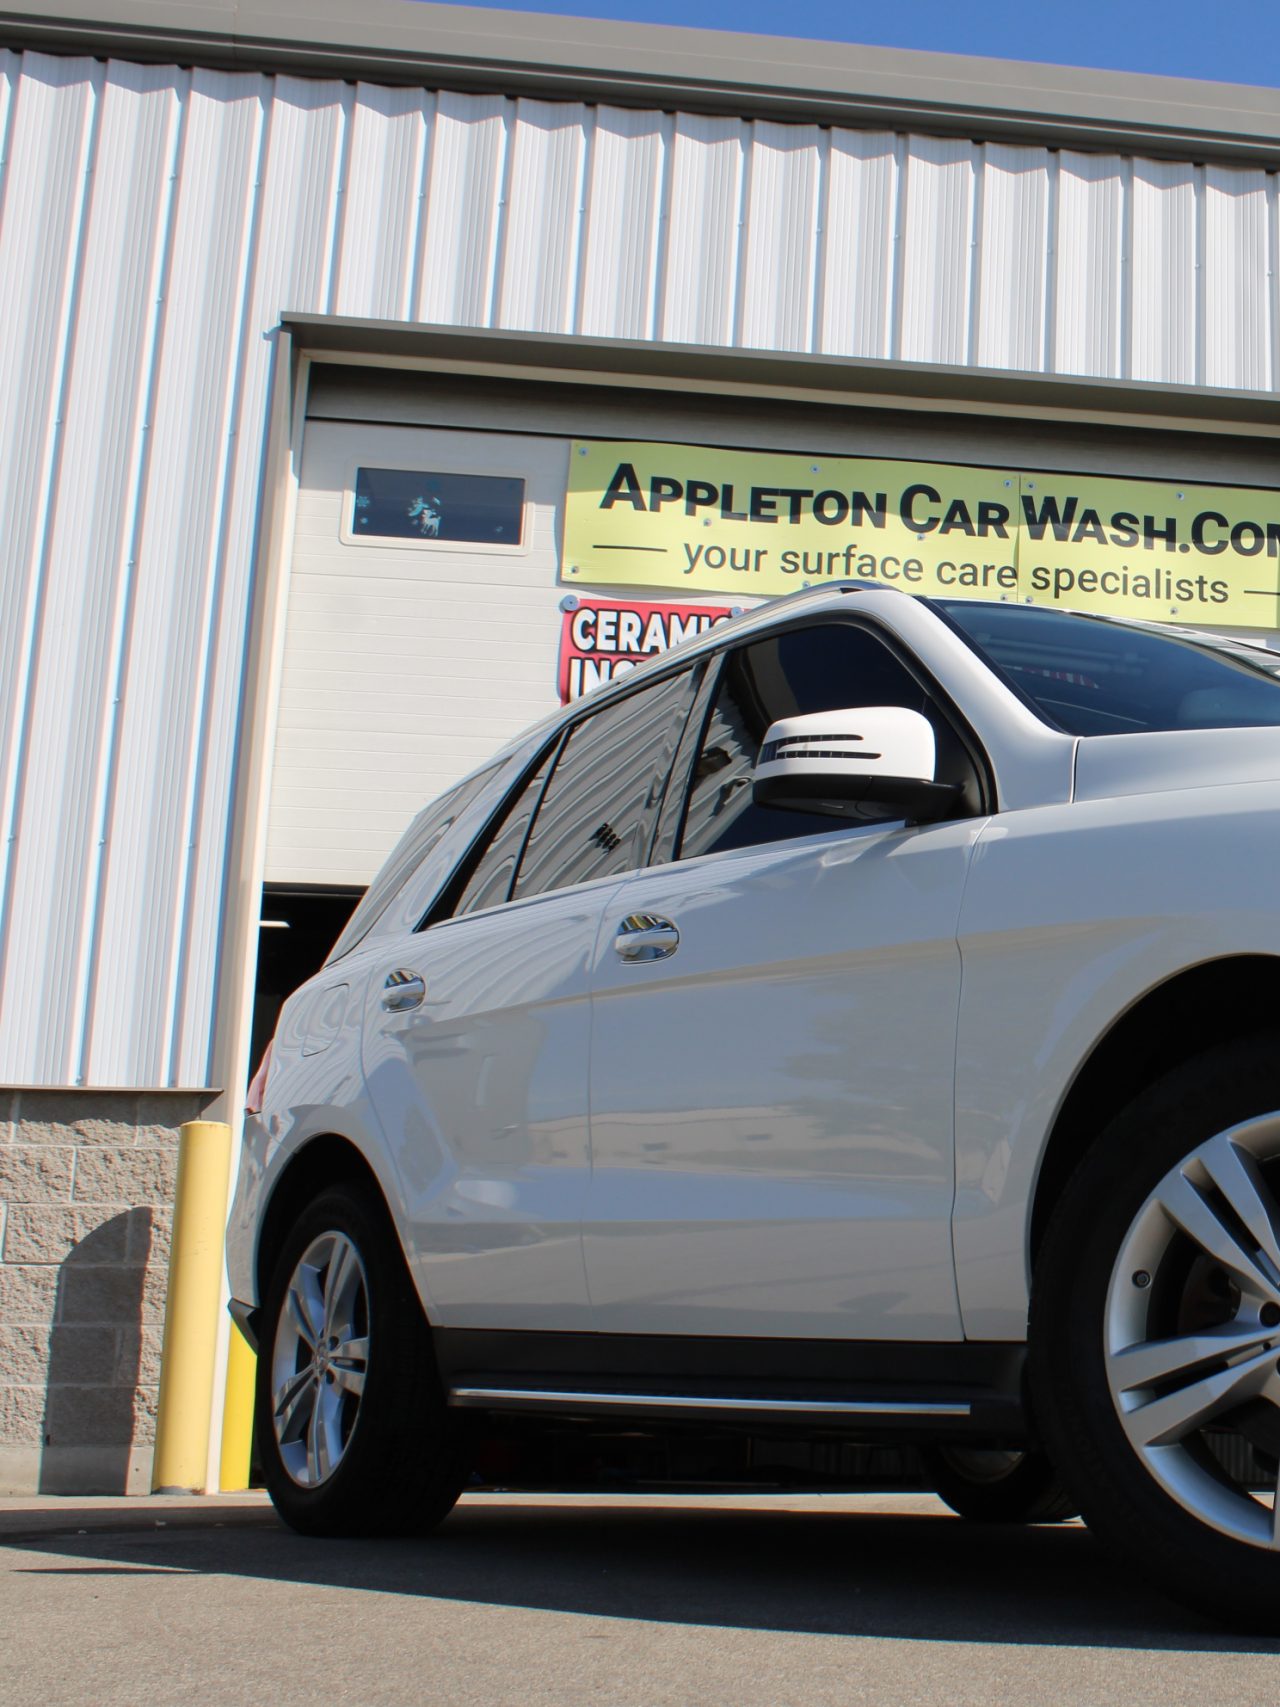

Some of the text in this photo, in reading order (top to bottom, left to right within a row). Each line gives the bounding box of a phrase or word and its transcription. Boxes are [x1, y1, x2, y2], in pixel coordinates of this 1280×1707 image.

[683, 542, 1230, 603] your surface care specialists
[572, 608, 732, 653] CERAM
